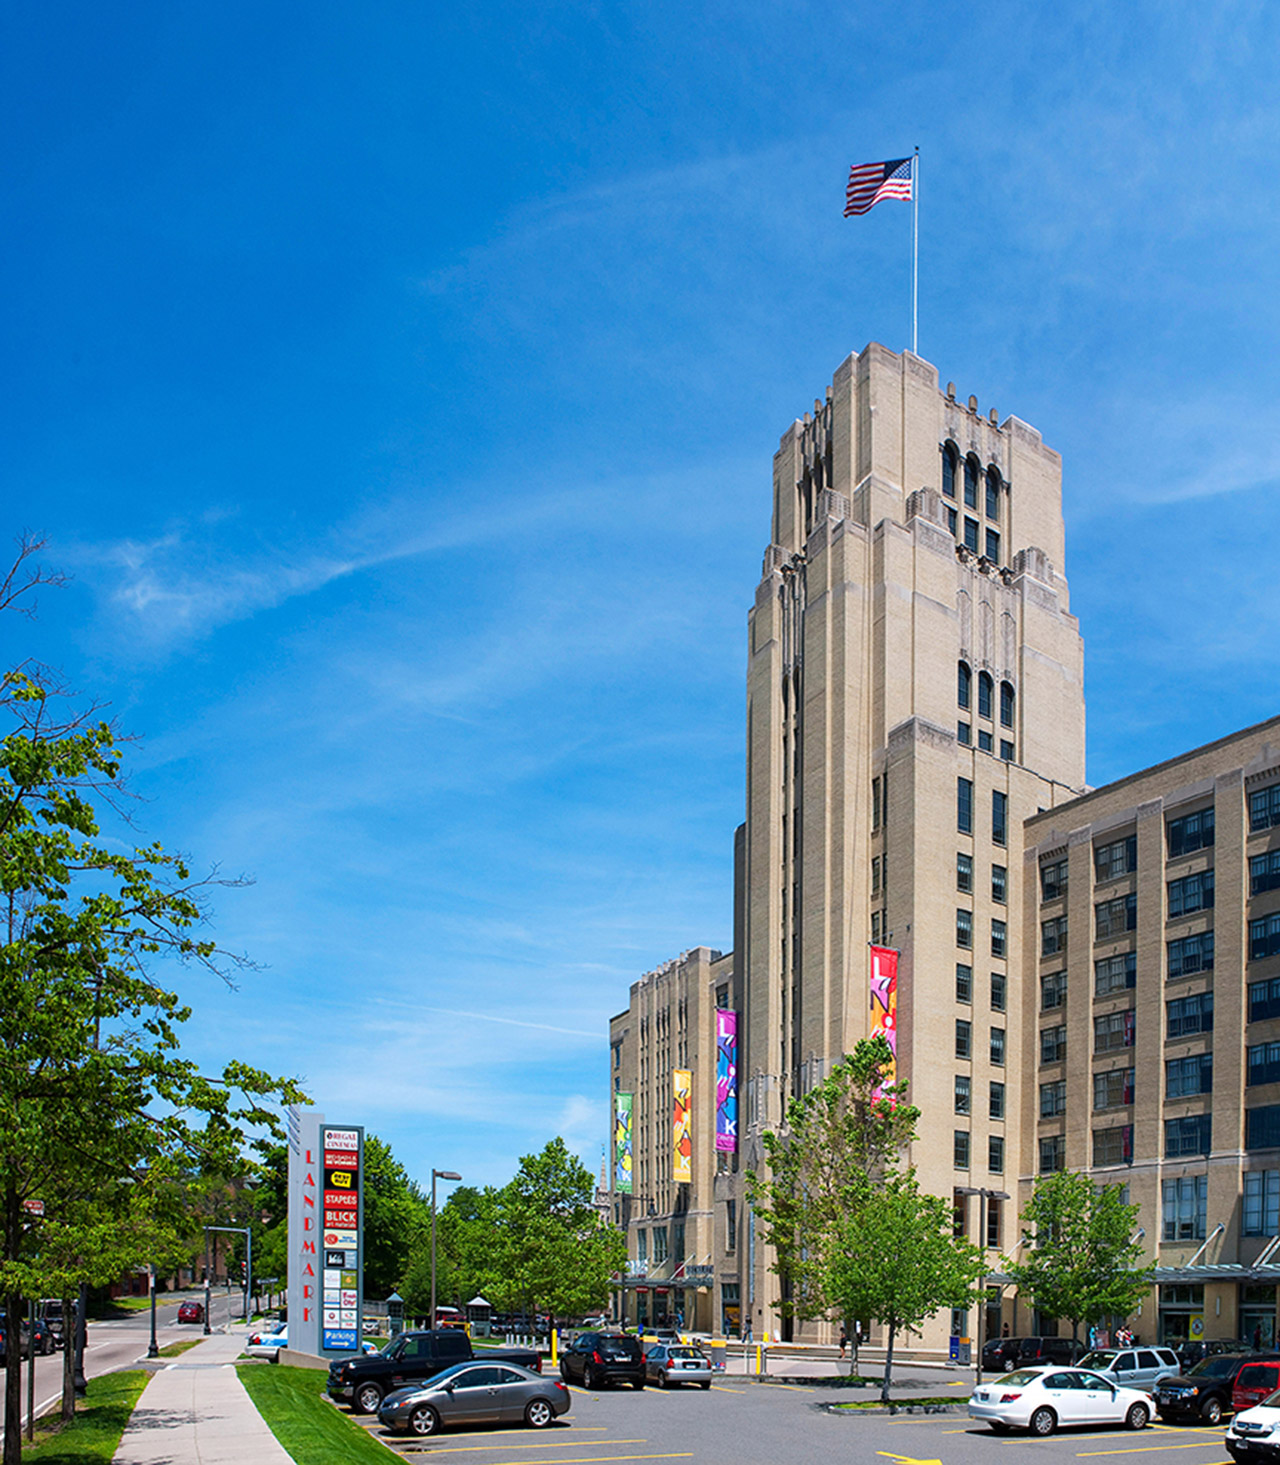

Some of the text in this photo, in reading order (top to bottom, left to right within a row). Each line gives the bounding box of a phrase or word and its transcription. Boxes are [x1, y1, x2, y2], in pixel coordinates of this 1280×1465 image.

[333, 1132, 356, 1141] REGAL
[325, 1194, 357, 1205] STAPLES
[326, 1211, 356, 1222] BLICK
[302, 1149, 316, 1322] LANDMARK
[325, 1331, 355, 1342] Parking
